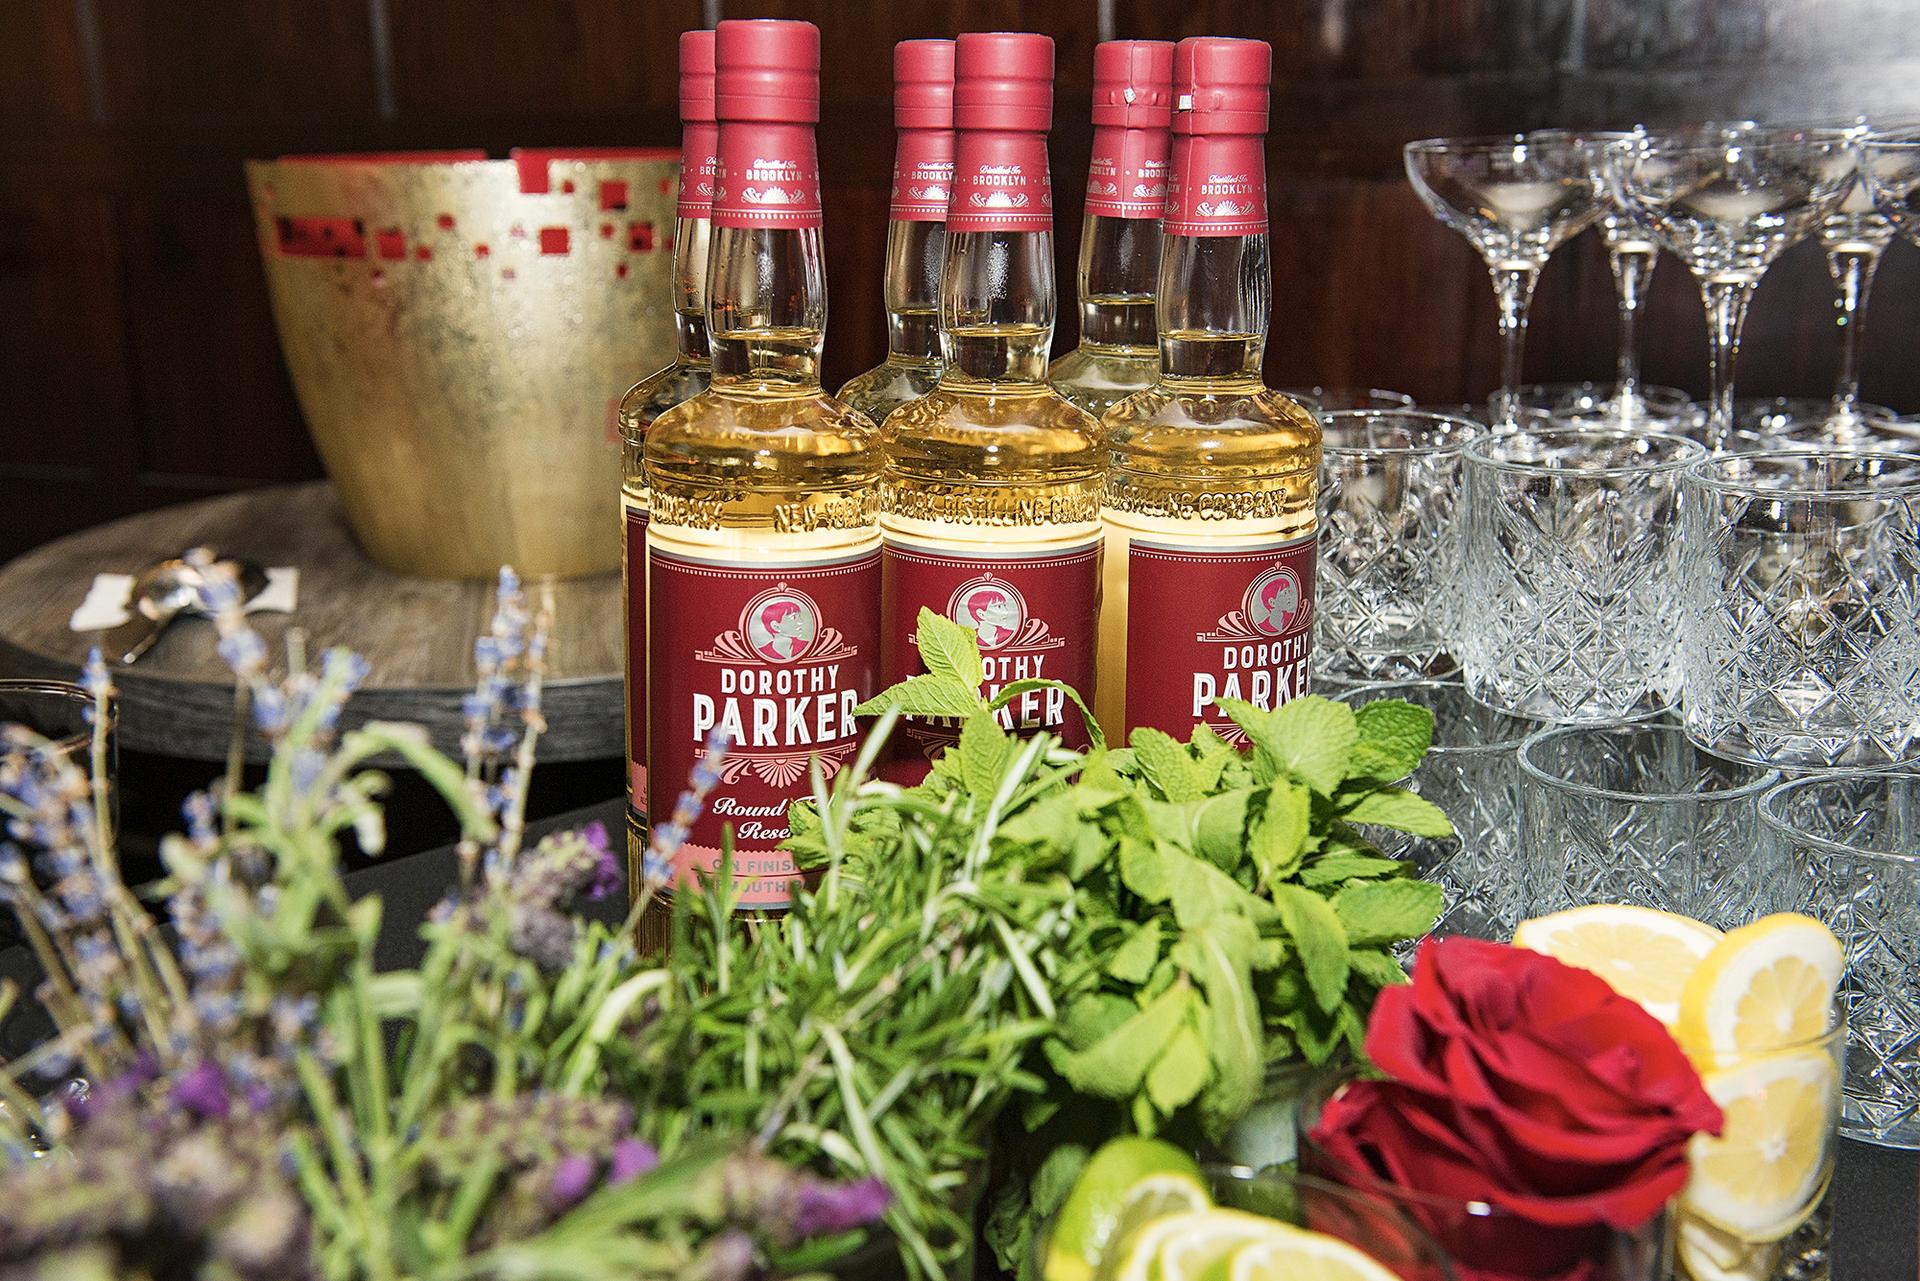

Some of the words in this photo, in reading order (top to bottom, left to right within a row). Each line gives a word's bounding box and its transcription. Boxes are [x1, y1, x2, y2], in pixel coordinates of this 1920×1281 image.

[745, 168, 802, 182] BROOKLYN
[911, 171, 953, 181] BROOKLY
[973, 175, 1027, 187] BROOKLYN
[1201, 183, 1253, 196] BROOKLYN
[1223, 631, 1309, 670] DOROTHY
[982, 654, 1045, 681] OTHY
[721, 664, 840, 695] DOROTHY
[693, 688, 858, 748] PARKER
[712, 797, 788, 818] Round
